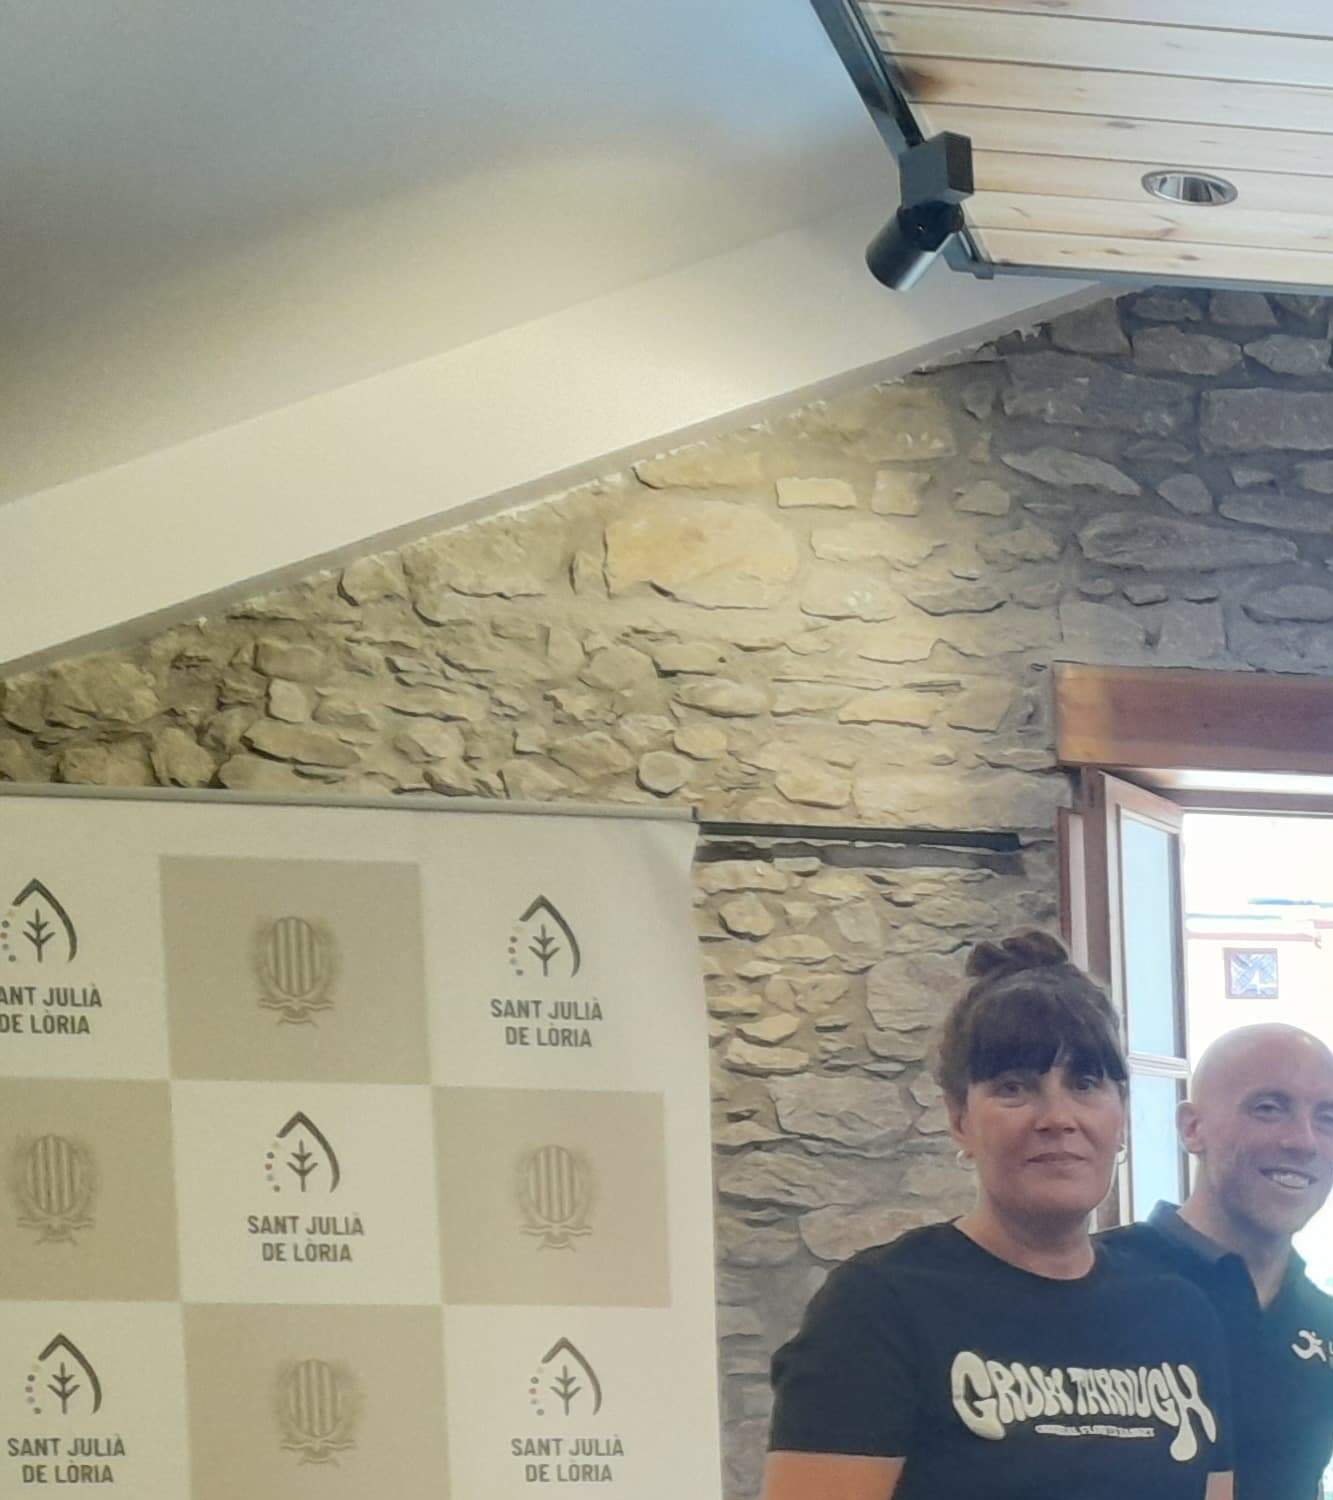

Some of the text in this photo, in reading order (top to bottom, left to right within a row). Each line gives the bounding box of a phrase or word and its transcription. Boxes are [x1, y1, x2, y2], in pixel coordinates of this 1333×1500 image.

[42, 982, 103, 1008] JULIÀ
[0, 1008, 91, 1034] DE LÒRIA
[490, 996, 604, 1021] SANT JULIÀ
[505, 1021, 593, 1048] DE LÒRIA
[247, 1211, 365, 1236] SANT JULIÀ
[262, 1237, 353, 1263] DE LÒRIA
[951, 1350, 1217, 1462] GROW THROUGH
[7, 1433, 126, 1457] SANT JULIÀ
[511, 1433, 625, 1457] SANT JULIÀ
[22, 1459, 115, 1484] DE LÒRIA
[525, 1458, 614, 1483] DE LÒRIA
